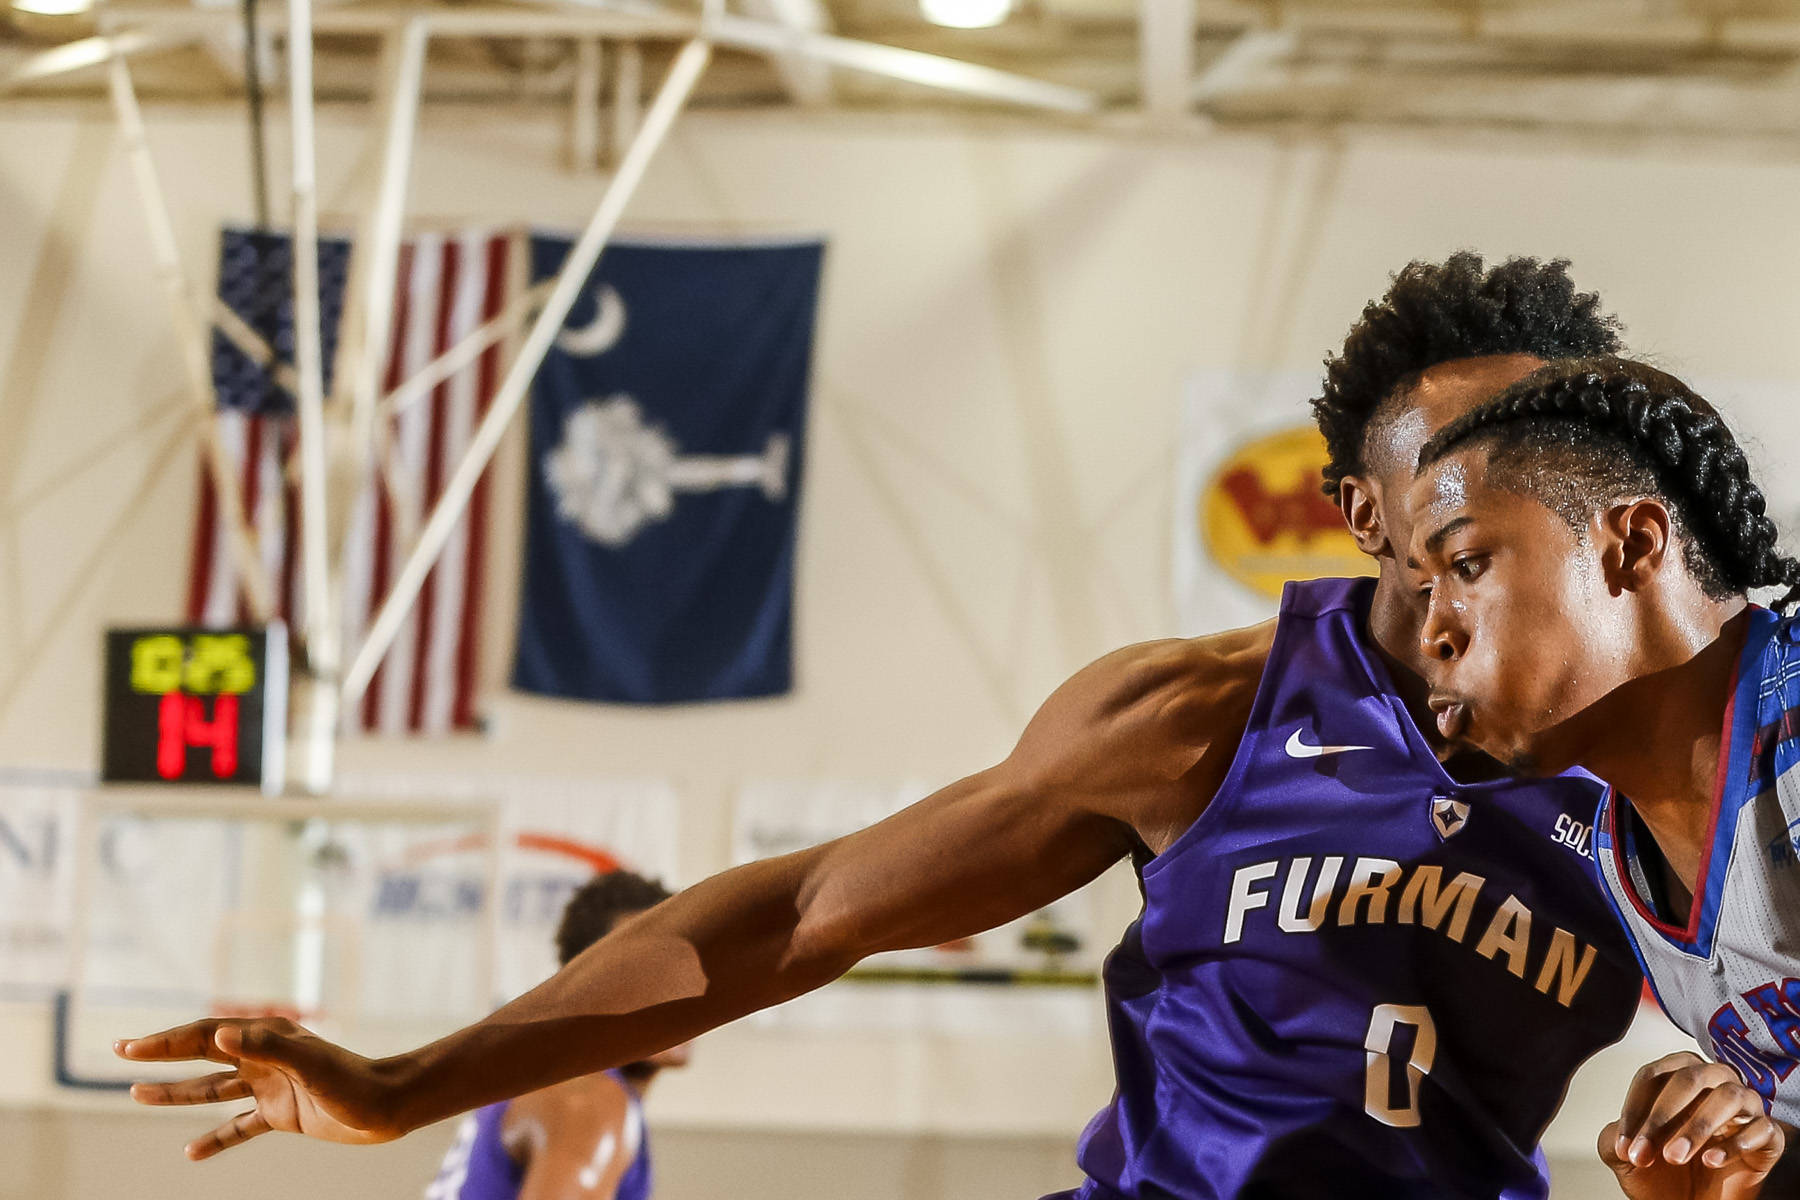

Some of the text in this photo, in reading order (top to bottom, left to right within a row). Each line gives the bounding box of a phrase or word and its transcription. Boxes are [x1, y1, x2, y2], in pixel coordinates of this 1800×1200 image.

[157, 688, 239, 780] 14
[1550, 812, 1596, 862] SOC
[1221, 855, 1599, 1009] FURMAN
[1363, 1003, 1437, 1128] 0
